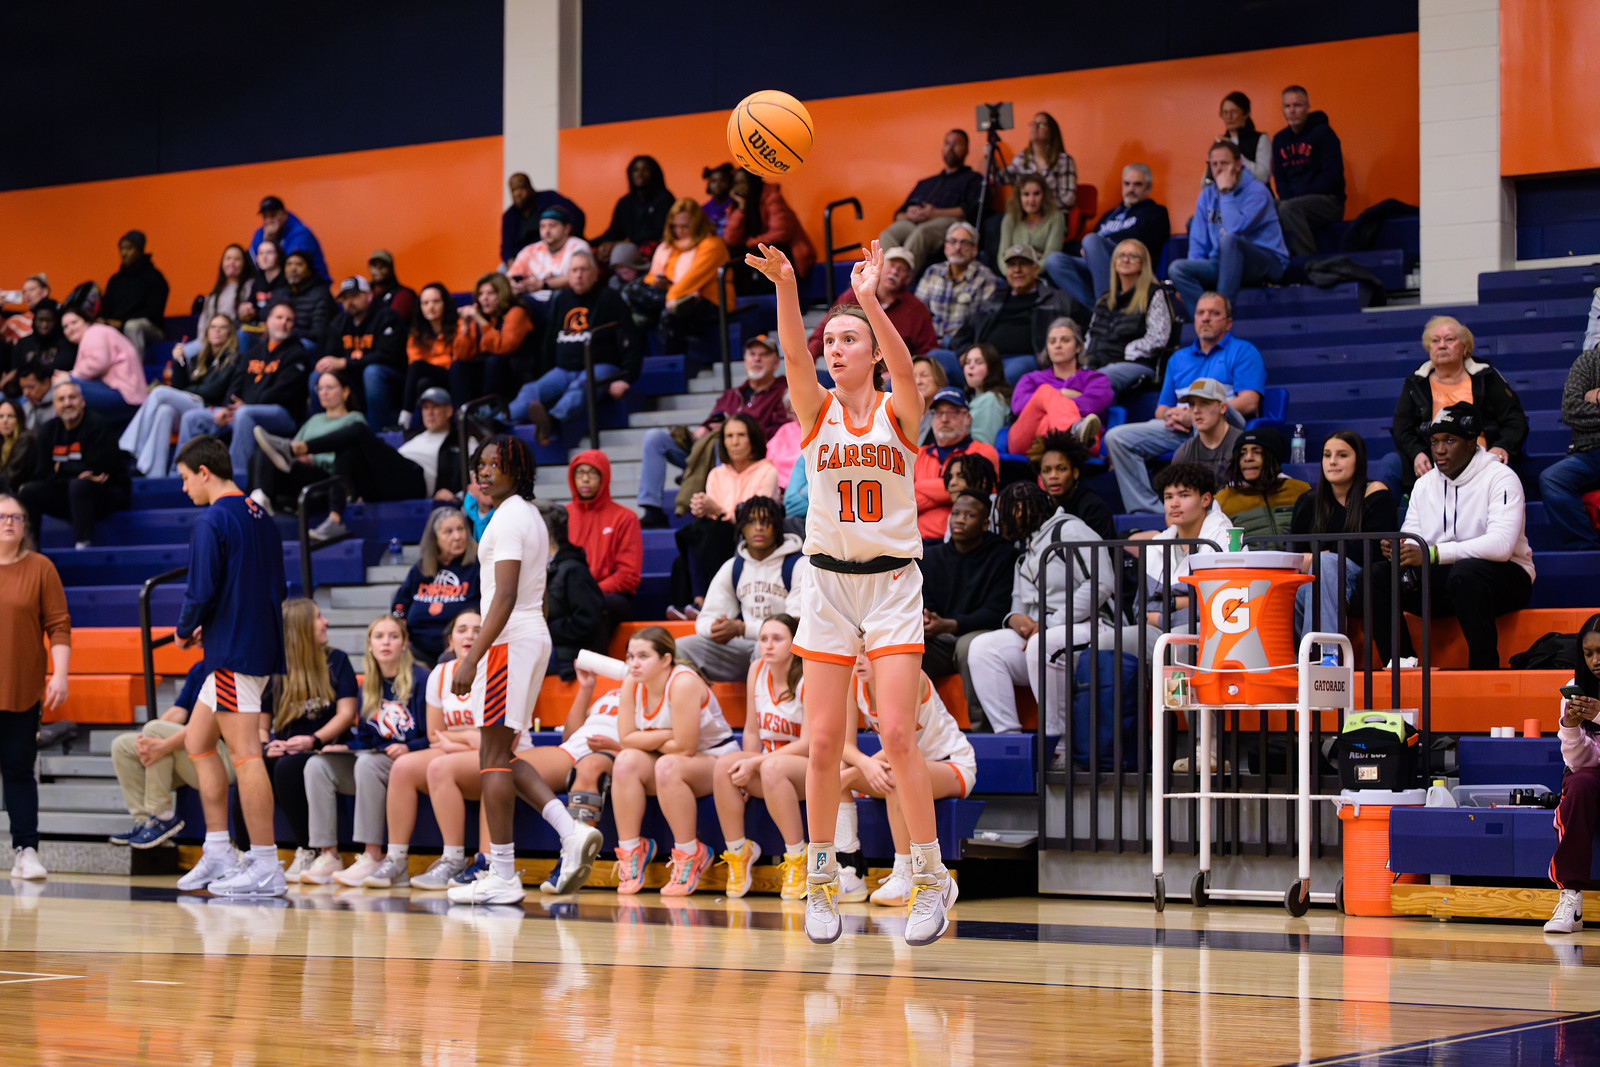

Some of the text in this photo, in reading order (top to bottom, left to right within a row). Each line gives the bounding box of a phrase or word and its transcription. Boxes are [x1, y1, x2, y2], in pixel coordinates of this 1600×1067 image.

[748, 129, 790, 172] Wilson
[817, 443, 905, 477] CARSON
[837, 480, 883, 523] 10
[1211, 587, 1250, 634] G
[1314, 680, 1345, 692] GATORADE
